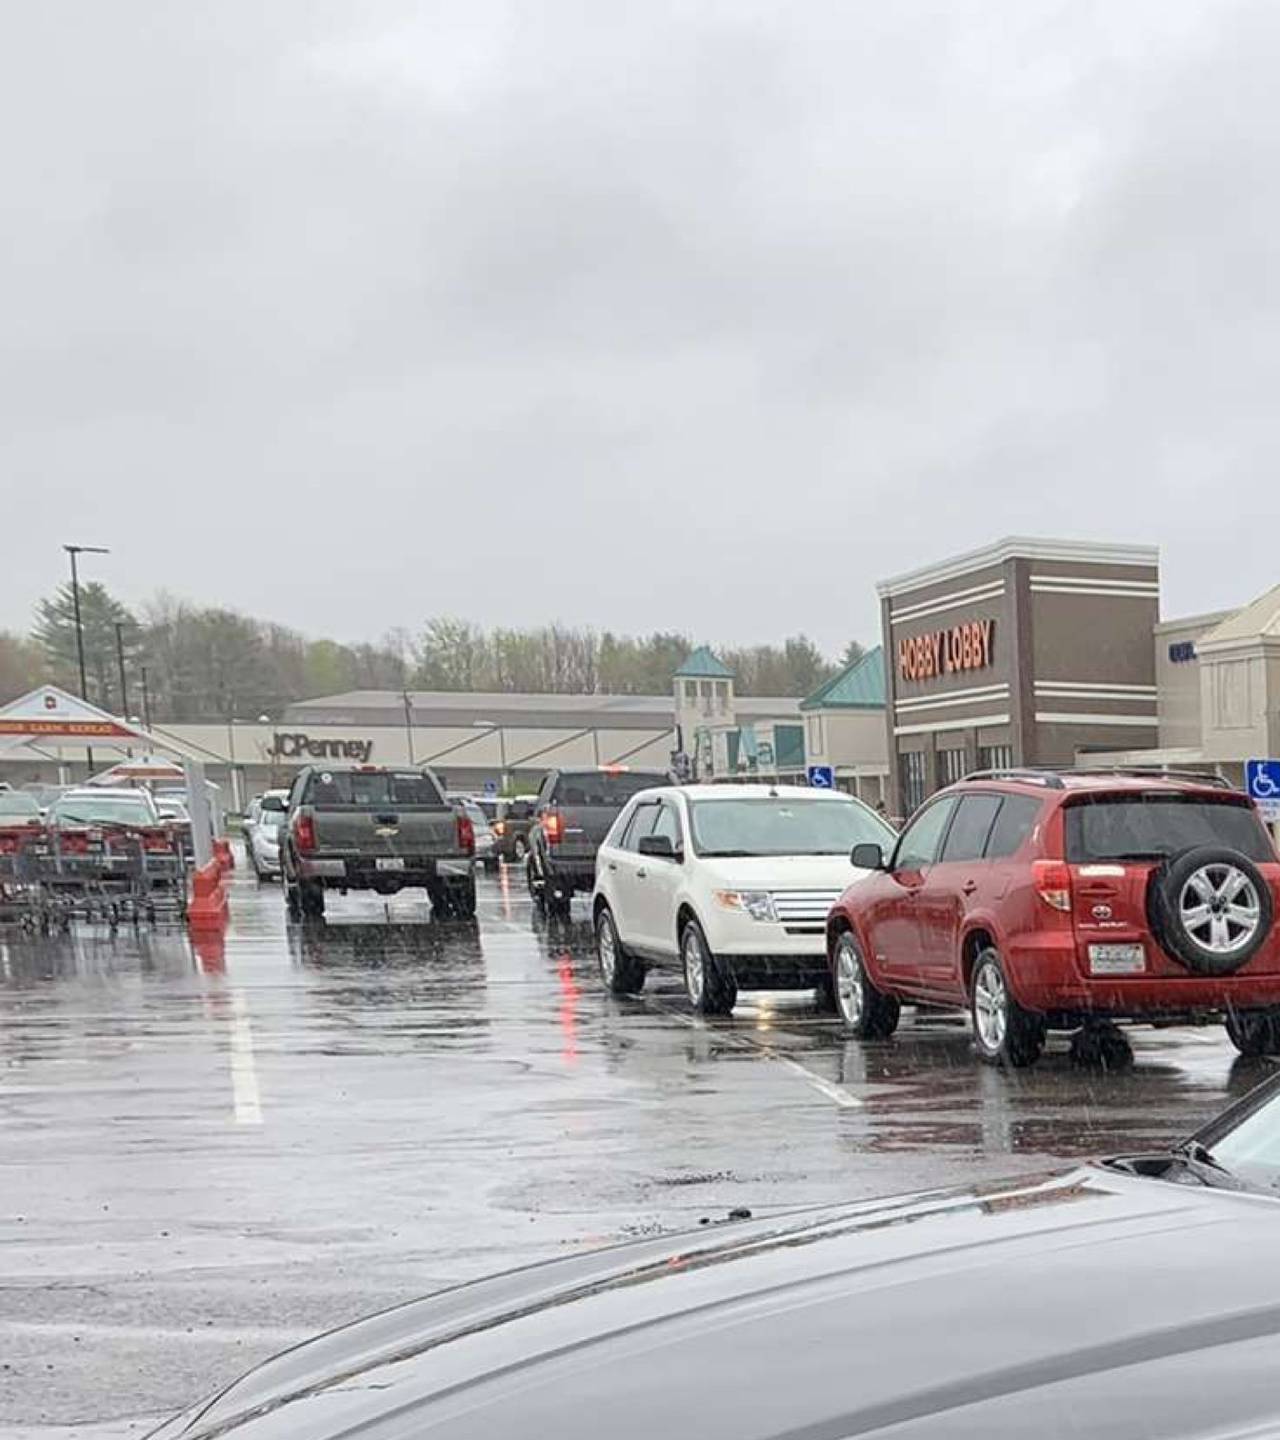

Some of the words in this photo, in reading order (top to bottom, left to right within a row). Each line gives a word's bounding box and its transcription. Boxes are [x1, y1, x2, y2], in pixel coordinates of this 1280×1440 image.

[898, 630, 944, 680] HOBBY
[943, 619, 995, 673] LOBBY
[266, 733, 373, 763] JCPenney
